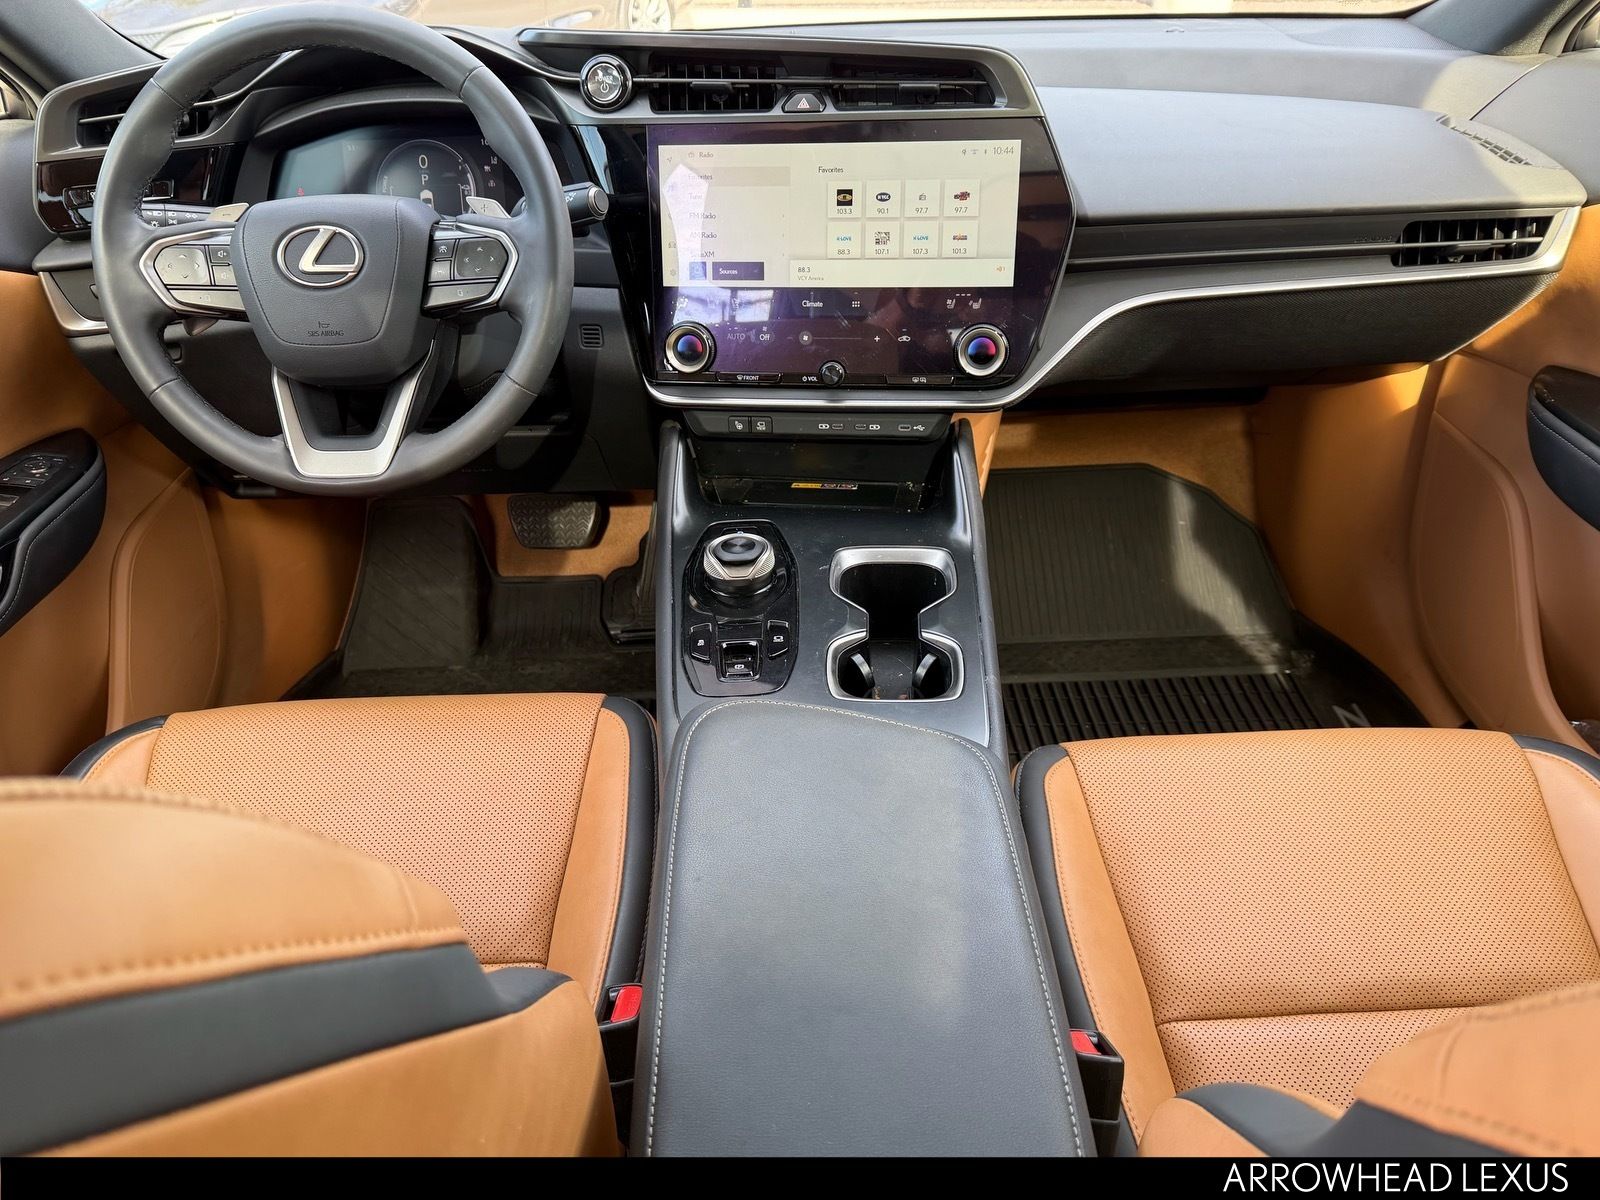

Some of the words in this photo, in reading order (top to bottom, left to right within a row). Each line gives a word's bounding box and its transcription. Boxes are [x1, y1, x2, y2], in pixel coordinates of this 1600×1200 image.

[993, 146, 1014, 155] 10:44
[818, 166, 844, 174] Favorites
[421, 174, 429, 185] P
[701, 212, 717, 220] Radio
[719, 267, 738, 275] Sources
[801, 299, 824, 308] Climate
[727, 332, 746, 341] AUTO
[759, 332, 770, 341] Off
